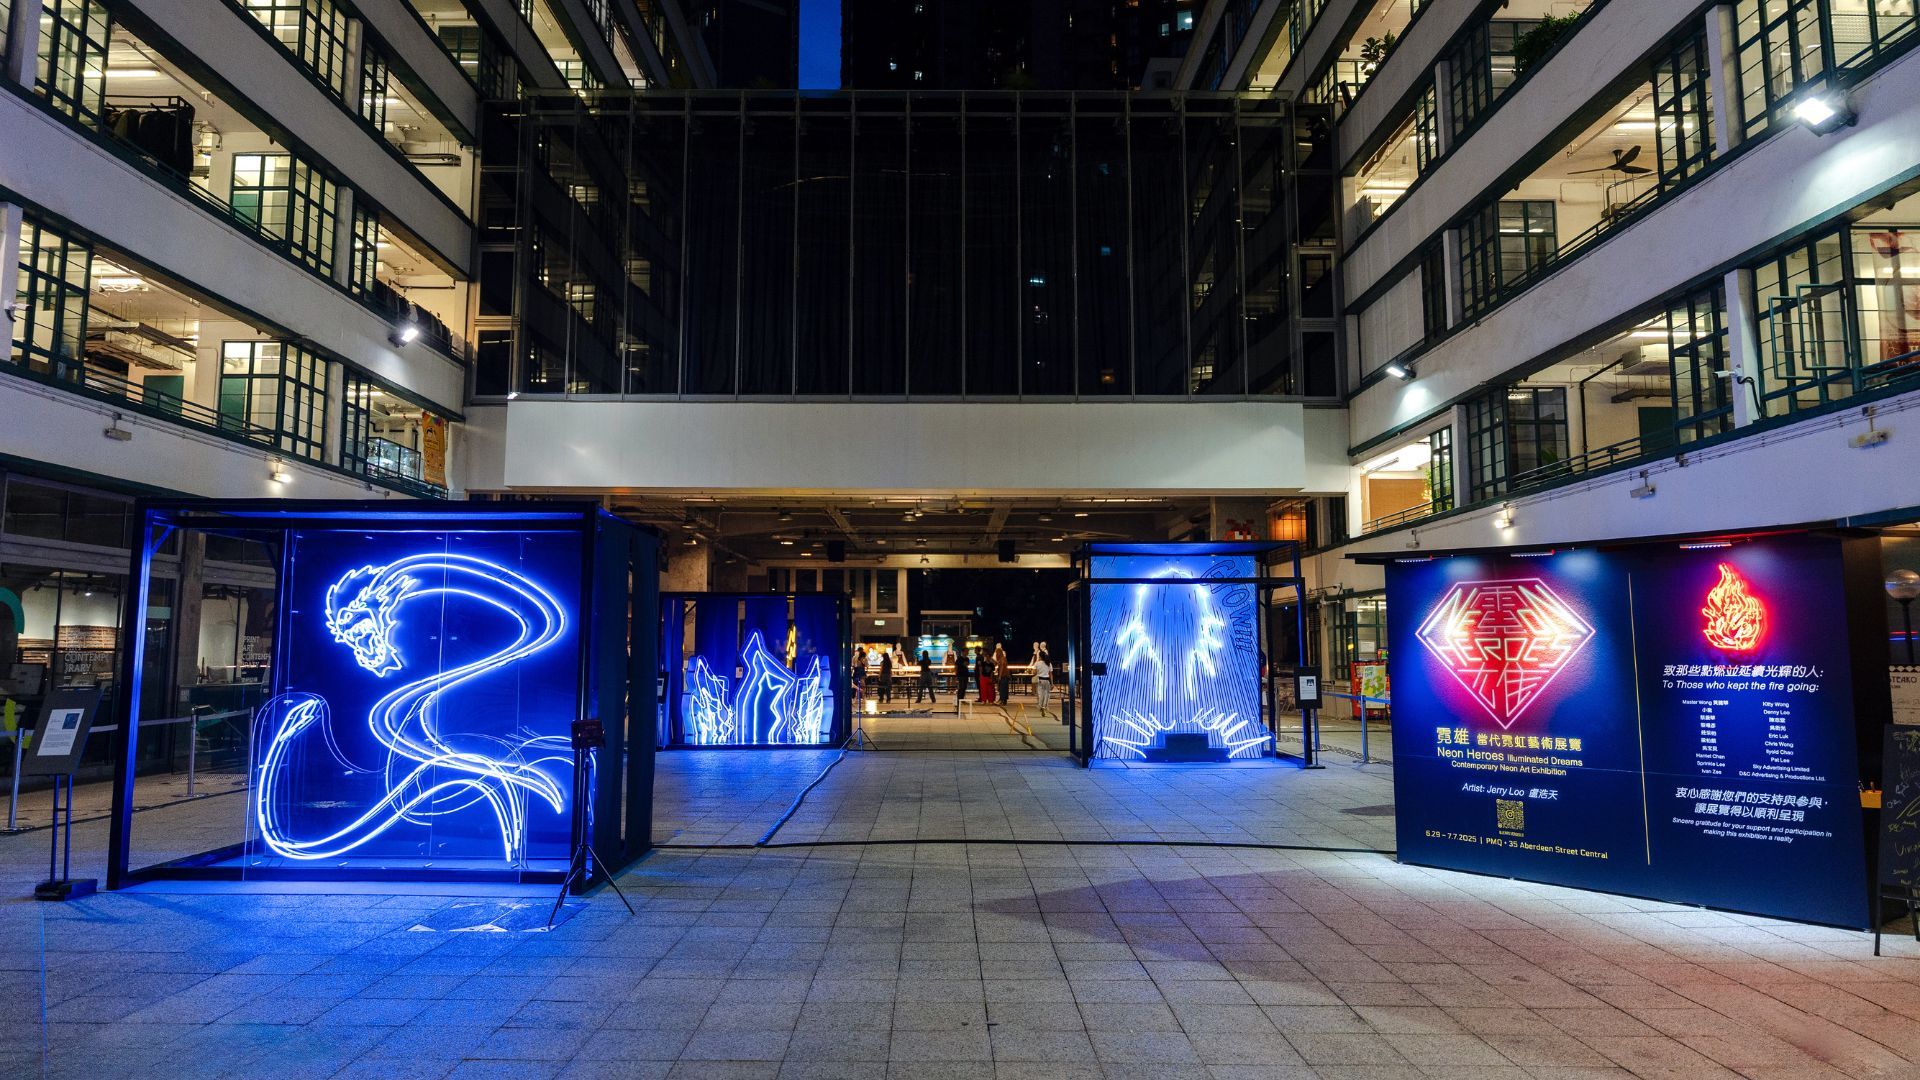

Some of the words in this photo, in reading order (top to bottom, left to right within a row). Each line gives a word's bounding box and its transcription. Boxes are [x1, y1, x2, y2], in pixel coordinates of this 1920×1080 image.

[1663, 680, 1674, 688] To
[1676, 681, 1703, 689] Those
[1727, 681, 1748, 691] kept
[1751, 681, 1766, 690] the
[1769, 682, 1784, 690] fire
[1787, 683, 1819, 693] going:
[1436, 728, 1470, 744] 霓雄
[1476, 733, 1582, 752] 當代霓虹藝術展覽
[1437, 747, 1464, 758] Neon
[1467, 748, 1504, 761] Heroes
[1507, 754, 1548, 764] Illuminated
[1551, 756, 1583, 767] Dreams
[1452, 760, 1498, 772] Contemporary
[1500, 764, 1518, 772] Neon
[1532, 767, 1567, 776] Exhibition
[1462, 782, 1485, 792] Artist:
[1487, 786, 1507, 797] Jerry
[1509, 787, 1525, 796] Loo
[1529, 788, 1558, 800] 盧浩天
[1695, 802, 1805, 822] 讓展覽得以順利呈現
[1672, 817, 1694, 826] Sincere
[1695, 819, 1721, 828] gratitude
[1746, 824, 1770, 833] support
[1784, 827, 1825, 838] participation
[1703, 828, 1725, 837] making
[1726, 829, 1737, 837] this
[1738, 831, 1767, 840] exhibition
[1425, 830, 1441, 838] 6.29
[1447, 832, 1477, 843] 7.7.2025
[1486, 838, 1502, 847] PMQ
[1519, 842, 1553, 853] Aberdeen
[1555, 845, 1578, 856] Street
[1580, 849, 1608, 859] Central
